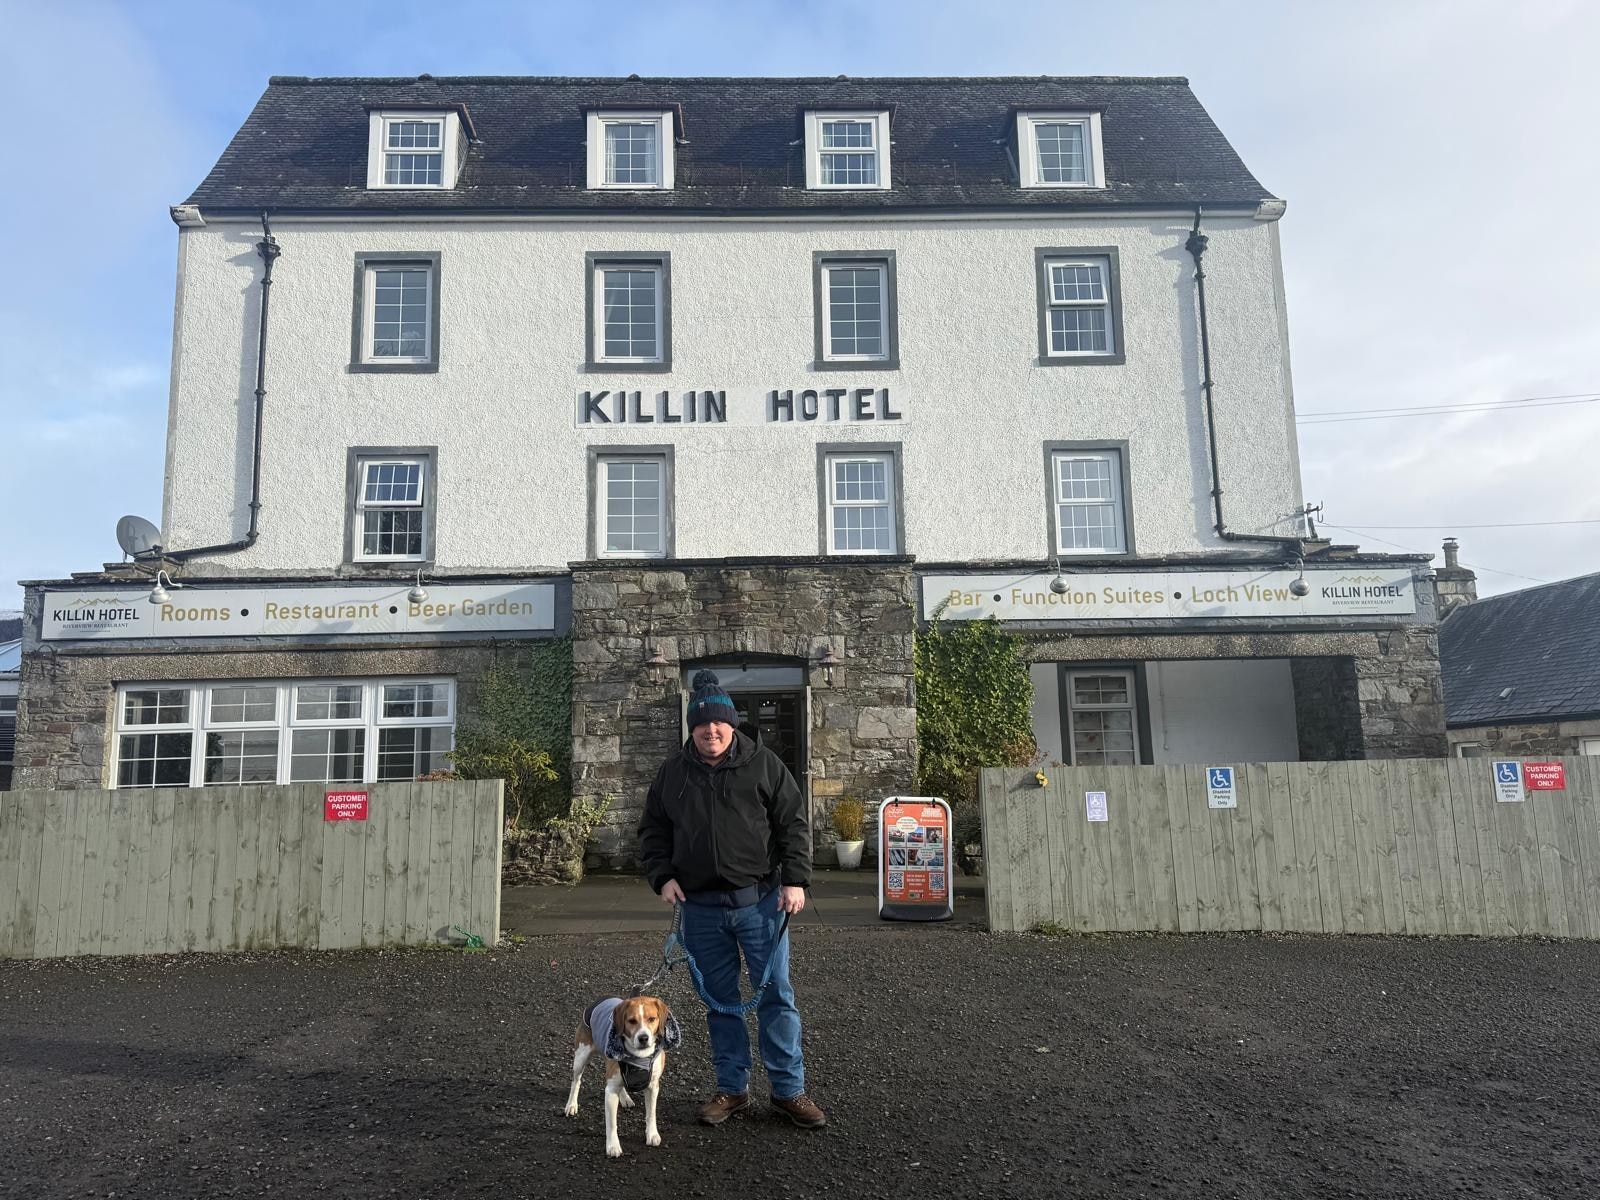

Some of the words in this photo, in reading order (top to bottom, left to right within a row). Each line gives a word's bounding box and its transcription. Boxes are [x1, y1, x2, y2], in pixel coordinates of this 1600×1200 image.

[584, 390, 727, 423] KILLIN
[772, 388, 902, 421] HOTEL
[950, 589, 982, 606] Bar
[1012, 588, 1097, 605] Function
[1103, 587, 1164, 604] Suites
[1191, 585, 1239, 603] Loch
[1322, 587, 1361, 598] KILLIN
[1364, 586, 1404, 597] HOTEL
[53, 609, 95, 621] KILLIN
[99, 608, 140, 620] HOTEL
[161, 604, 231, 621] Rooms
[265, 602, 379, 620] Restaurant
[408, 601, 456, 617] Beer
[462, 599, 533, 616] Garden
